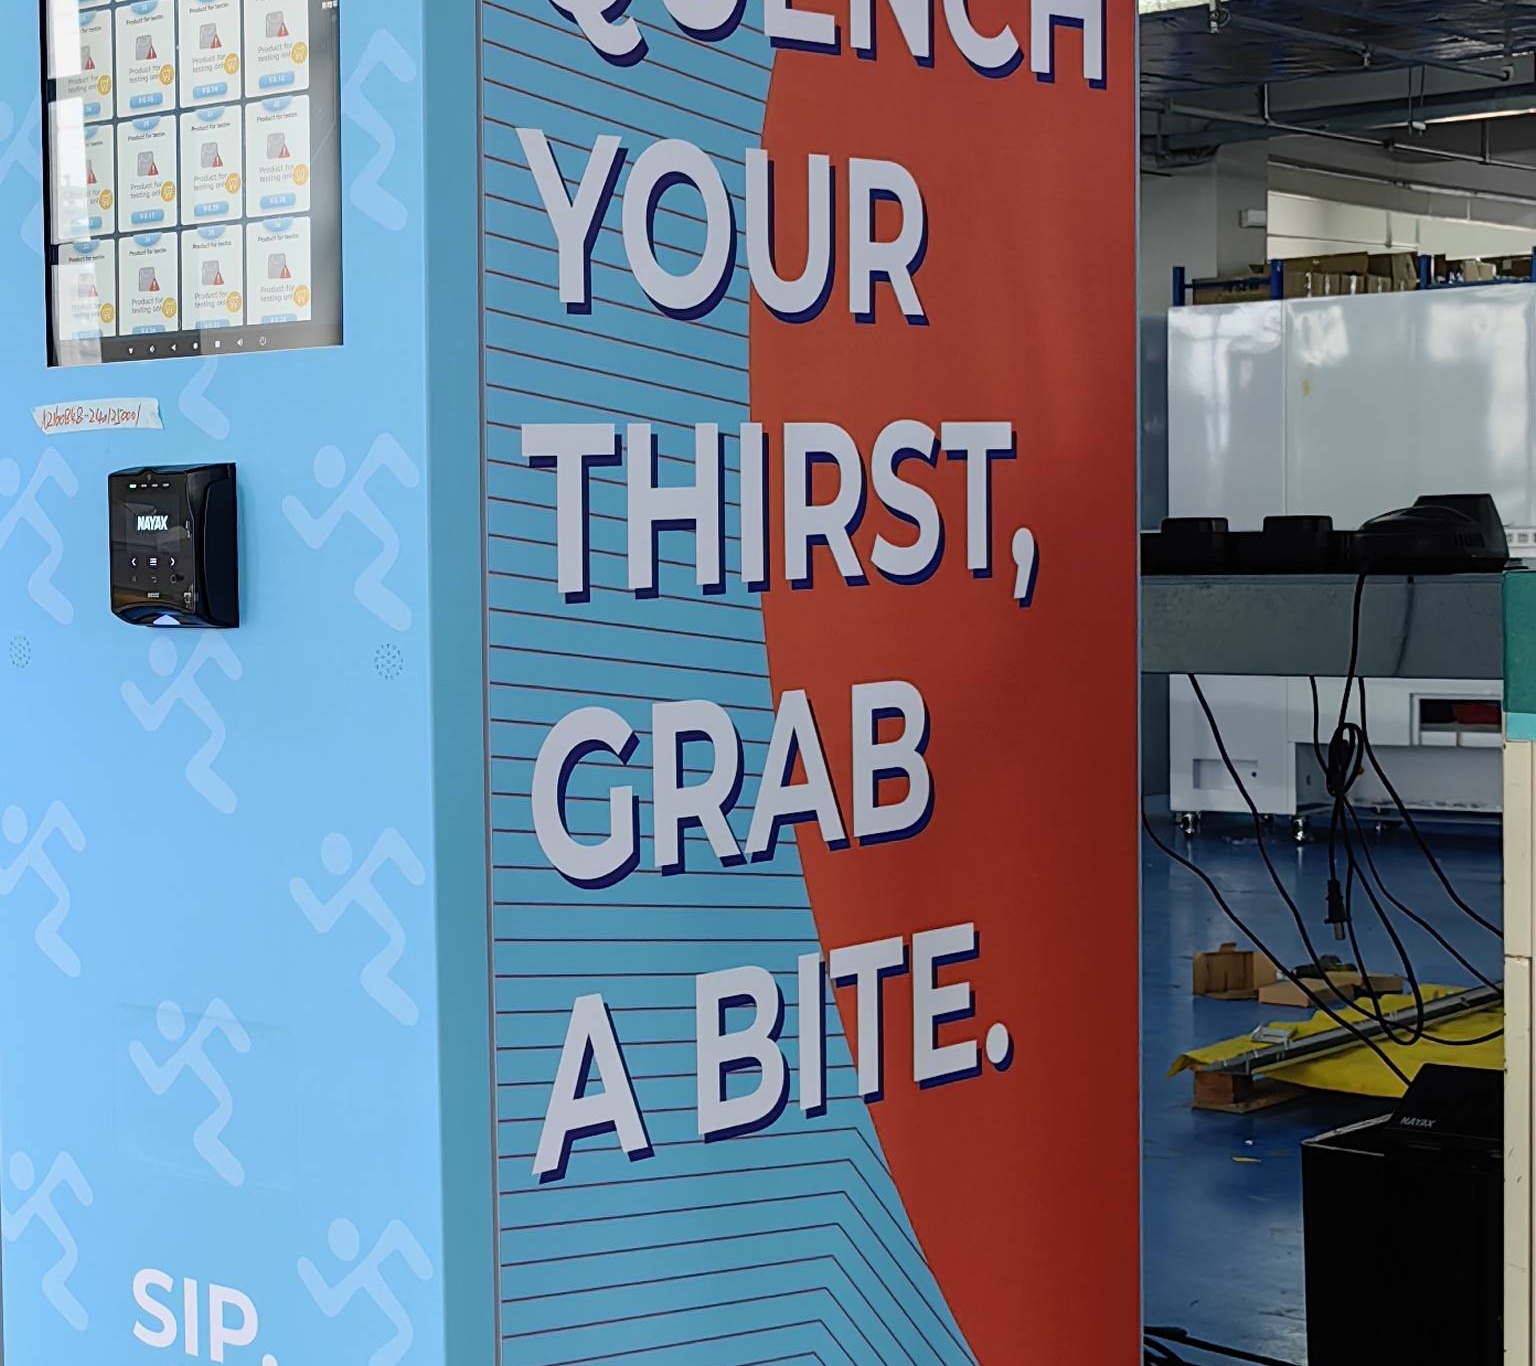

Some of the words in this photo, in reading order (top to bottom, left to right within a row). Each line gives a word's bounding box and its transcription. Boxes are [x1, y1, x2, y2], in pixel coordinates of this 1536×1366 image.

[516, 128, 929, 325] YOUR
[137, 515, 169, 532] NAYAX
[522, 419, 1039, 607] THIRST,
[532, 680, 934, 890] GRAB
[532, 992, 655, 1184] A
[696, 922, 1015, 1144] BITE.
